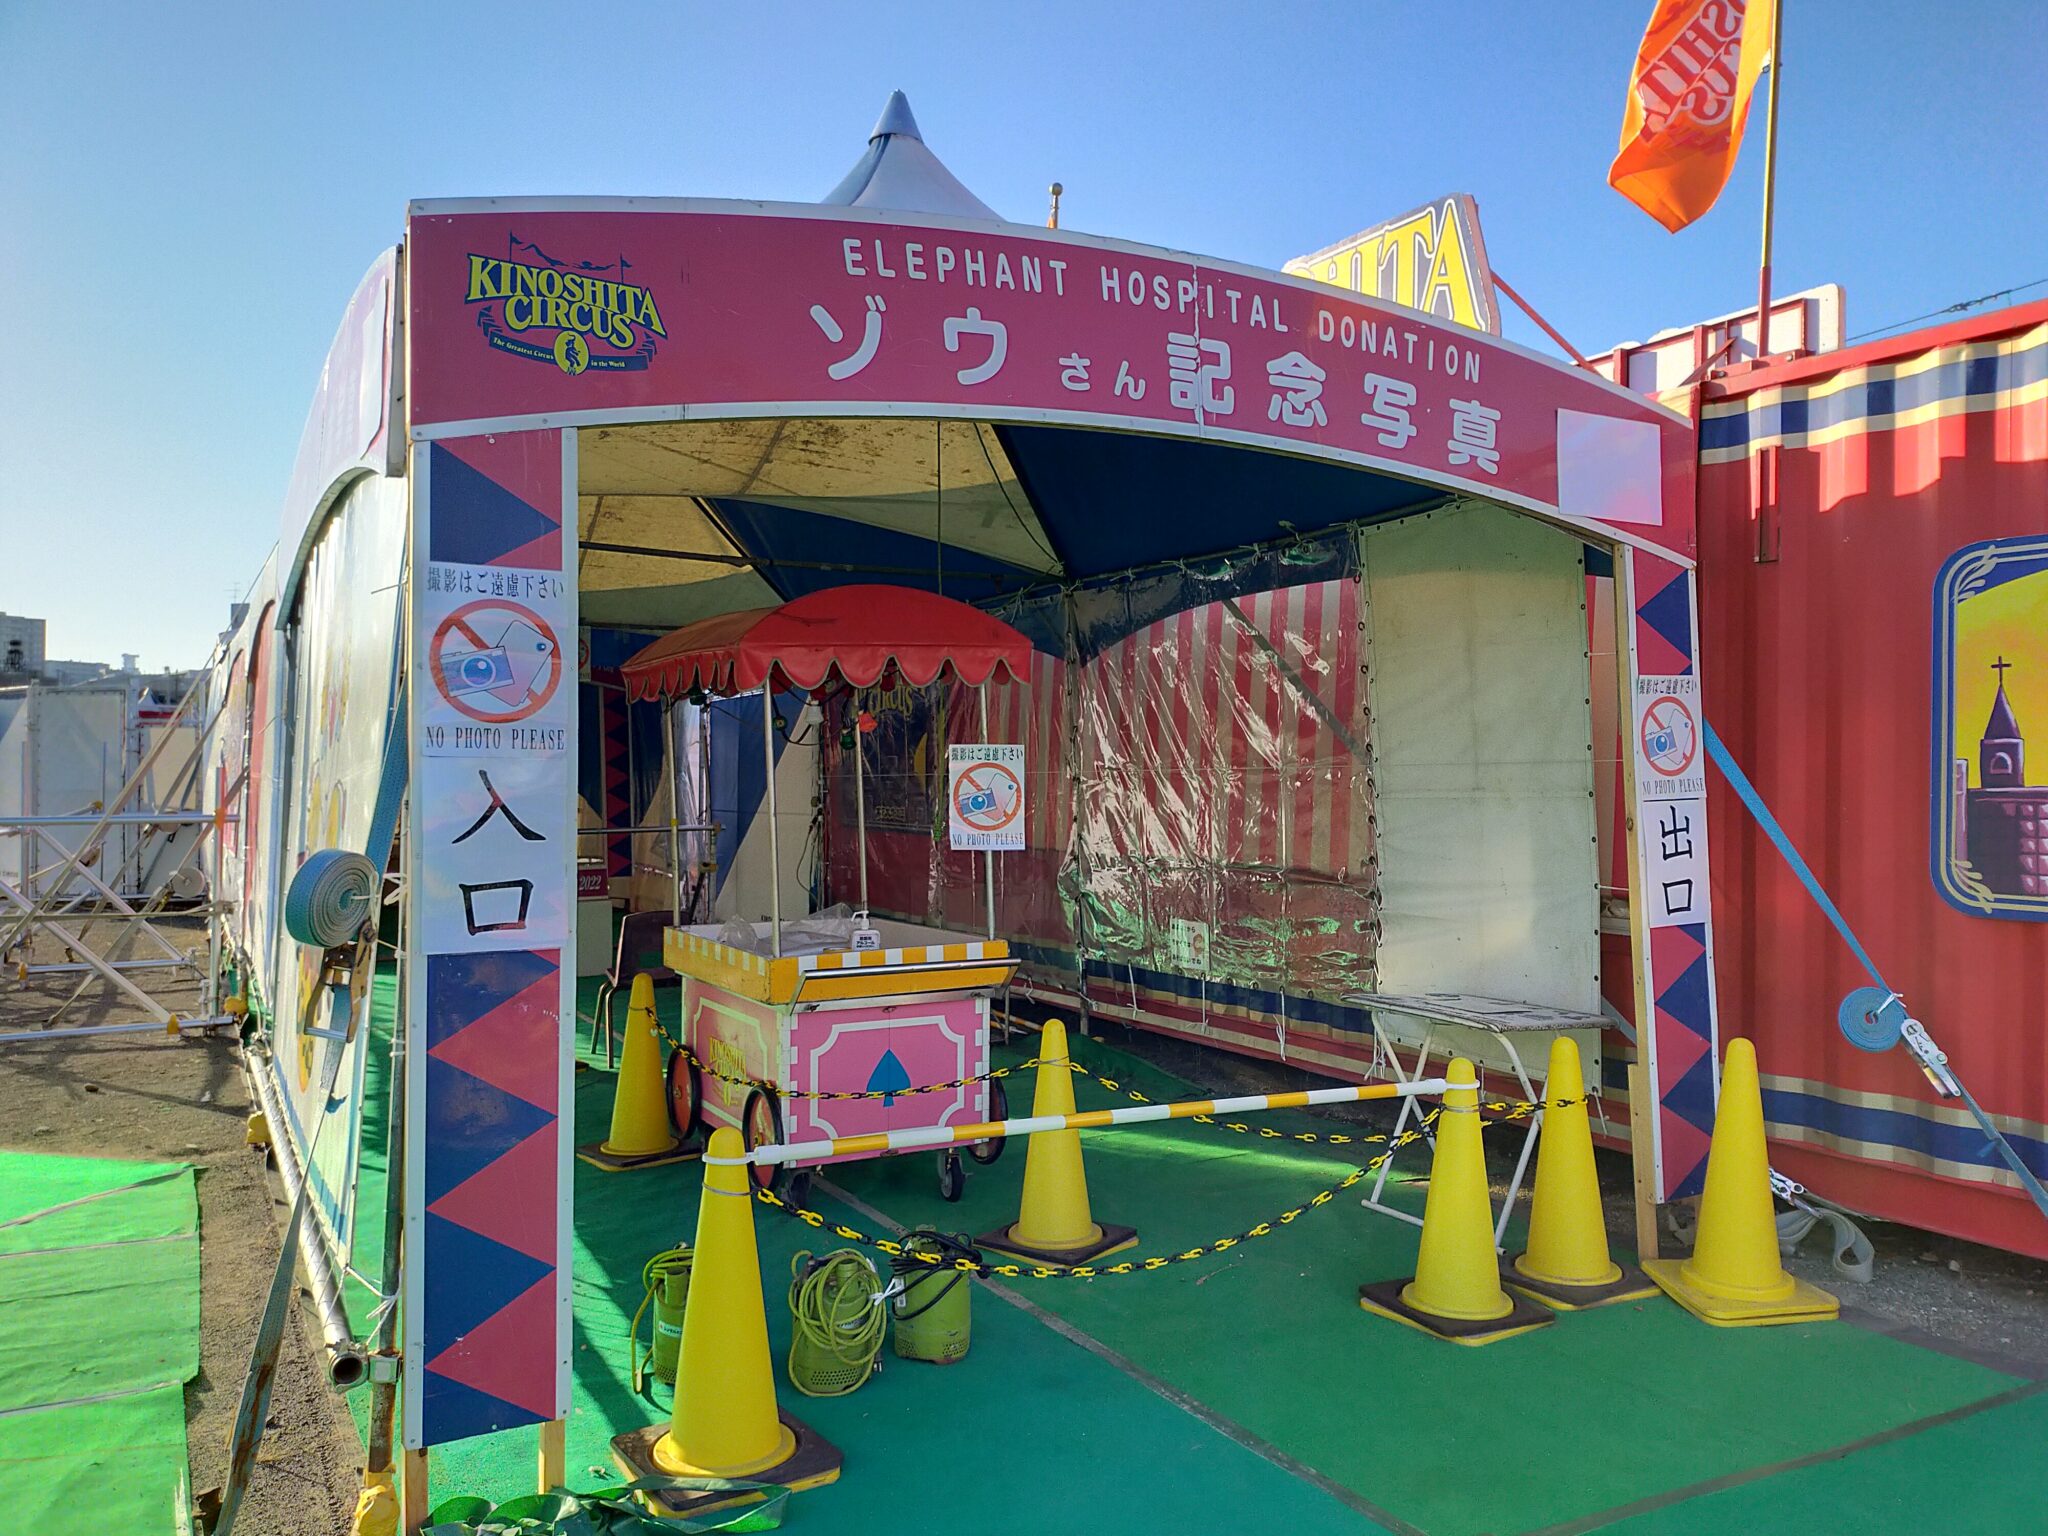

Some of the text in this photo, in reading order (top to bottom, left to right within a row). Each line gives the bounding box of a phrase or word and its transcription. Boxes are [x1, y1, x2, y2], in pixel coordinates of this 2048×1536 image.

[467, 255, 666, 335] KINOSHITA
[842, 238, 1481, 383] ELEPHANT HOSPITAL DONATION
[505, 295, 634, 348] CIRCUS
[493, 336, 505, 346] The
[506, 342, 533, 355] Greatest
[533, 350, 554, 360] Circus
[608, 360, 626, 368] World
[427, 566, 564, 599] 撮影はご遠慮下さい
[426, 726, 565, 750] NO PHOTO PLEASE
[1642, 777, 1704, 795] NO PHOTO PLEASE
[451, 769, 547, 936] 入口
[952, 832, 1024, 846] NO PHOTO PLEASE
[1660, 805, 1693, 916] 出口
